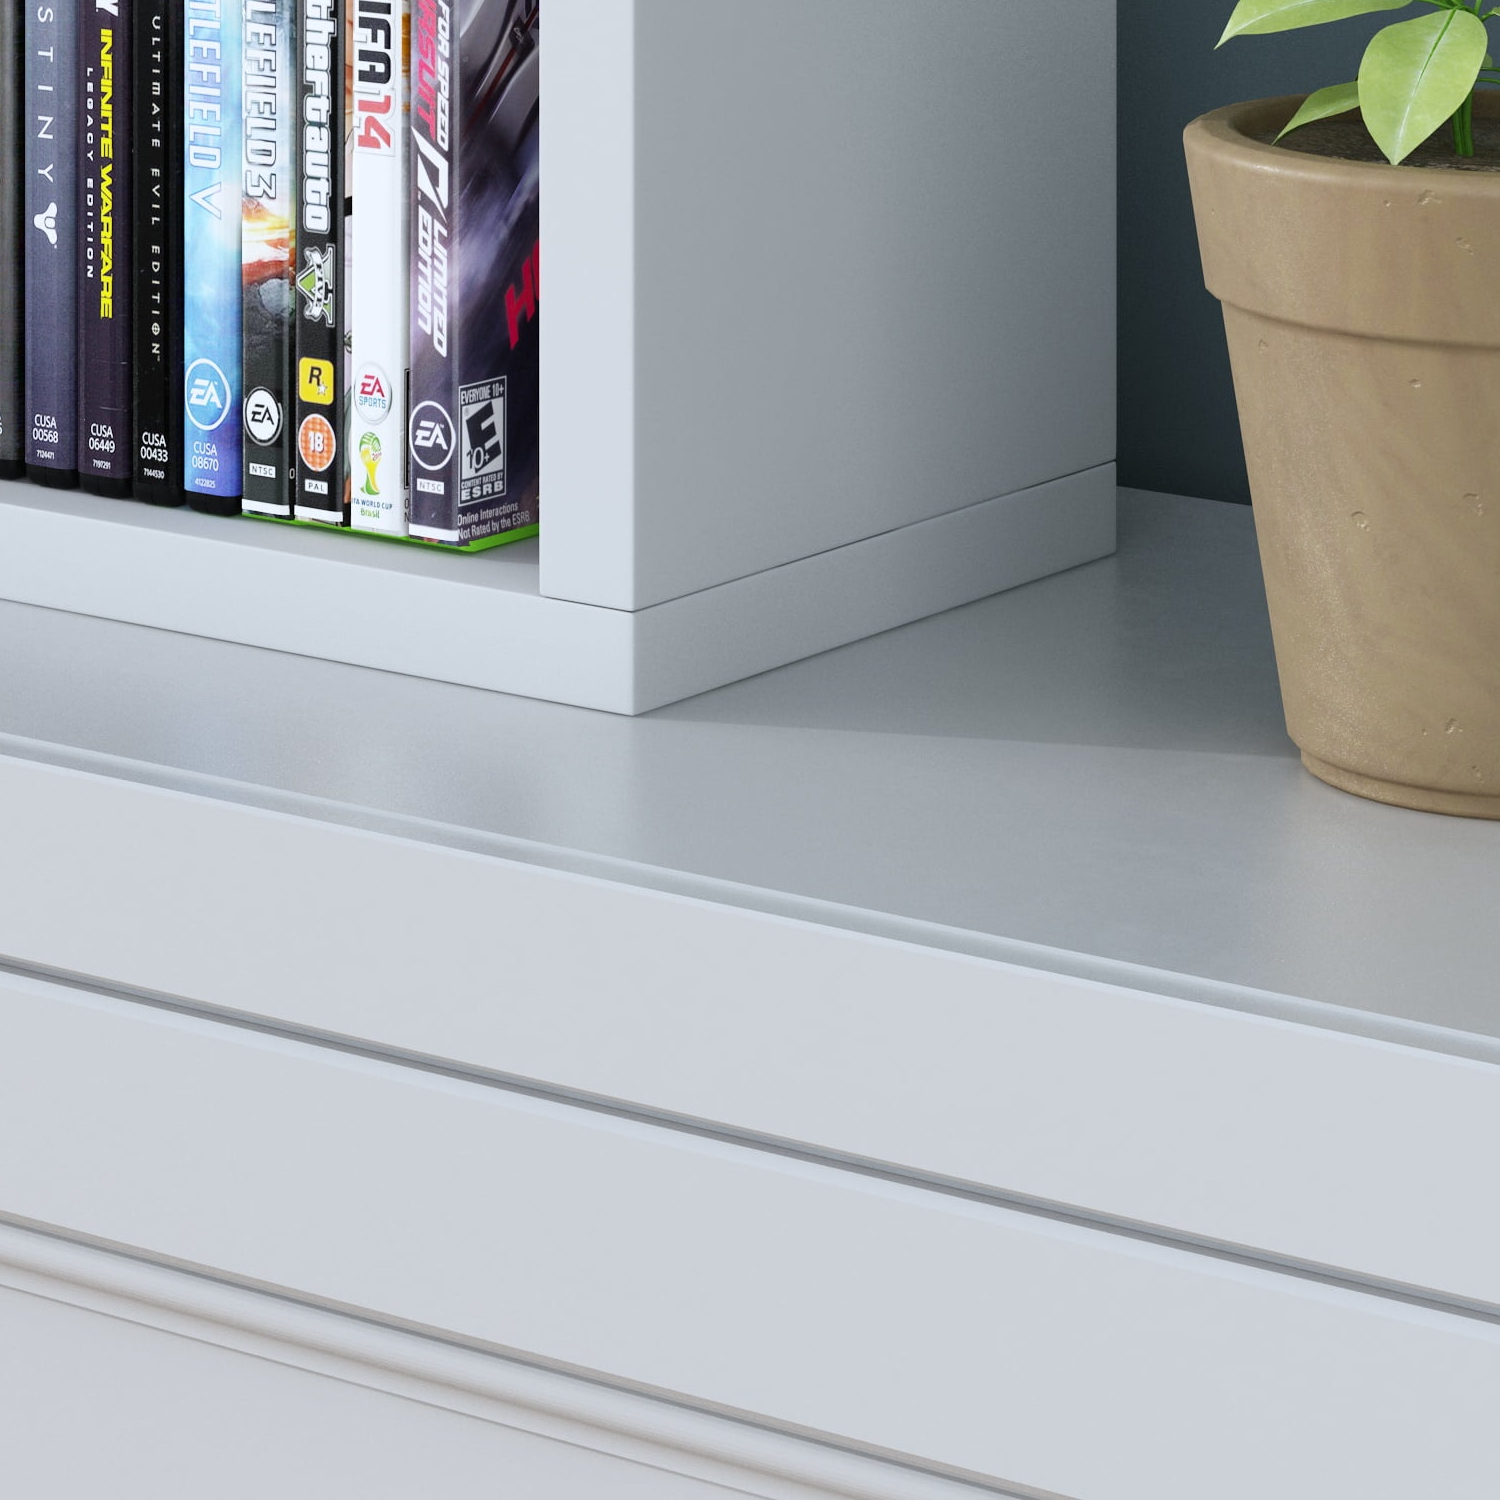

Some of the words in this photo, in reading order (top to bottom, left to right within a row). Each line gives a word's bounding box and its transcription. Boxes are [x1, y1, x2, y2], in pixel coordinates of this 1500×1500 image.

[151, 15, 161, 148] ULTIMATE
[100, 28, 113, 160] INFINITE
[436, 56, 451, 151] SPEED
[86, 66, 94, 162] LEGACY
[358, 94, 392, 149] 14
[245, 170, 277, 199] 3
[304, 125, 332, 233] auto
[151, 168, 161, 225] EVIL
[188, 181, 222, 220] V
[86, 177, 94, 278] EDITION
[100, 163, 113, 319] WARFARE
[418, 208, 432, 335] EDITION
[433, 218, 448, 358] LIMITED
[308, 366, 322, 387] R
[360, 374, 385, 398] EA
[190, 378, 222, 409] EA
[358, 396, 387, 410] SPORTS
[460, 384, 491, 405] EVERYONE
[491, 382, 505, 397] 10+
[34, 414, 57, 429] CUSA
[251, 403, 275, 427] EA
[32, 428, 59, 444] 00568
[90, 423, 114, 439] CUSA
[142, 431, 167, 447] CUSA
[308, 430, 325, 453] 18
[414, 420, 448, 450] EA
[466, 401, 501, 474] E
[89, 437, 116, 453] 06449
[140, 447, 168, 462] 00433
[193, 441, 217, 457] CUSA
[191, 455, 219, 472] 08670
[466, 446, 490, 469] 10+
[251, 465, 274, 477] NTSC
[461, 476, 481, 490] CONTENT
[482, 474, 497, 485] RATED
[308, 482, 325, 493] PAL
[419, 481, 443, 493] NTSC
[461, 480, 503, 501] ESRB
[458, 511, 479, 526] Online
[480, 502, 518, 520] Interactions
[458, 526, 471, 540] Not
[471, 521, 491, 536] Rated
[491, 519, 500, 532] by
[500, 515, 511, 529] the
